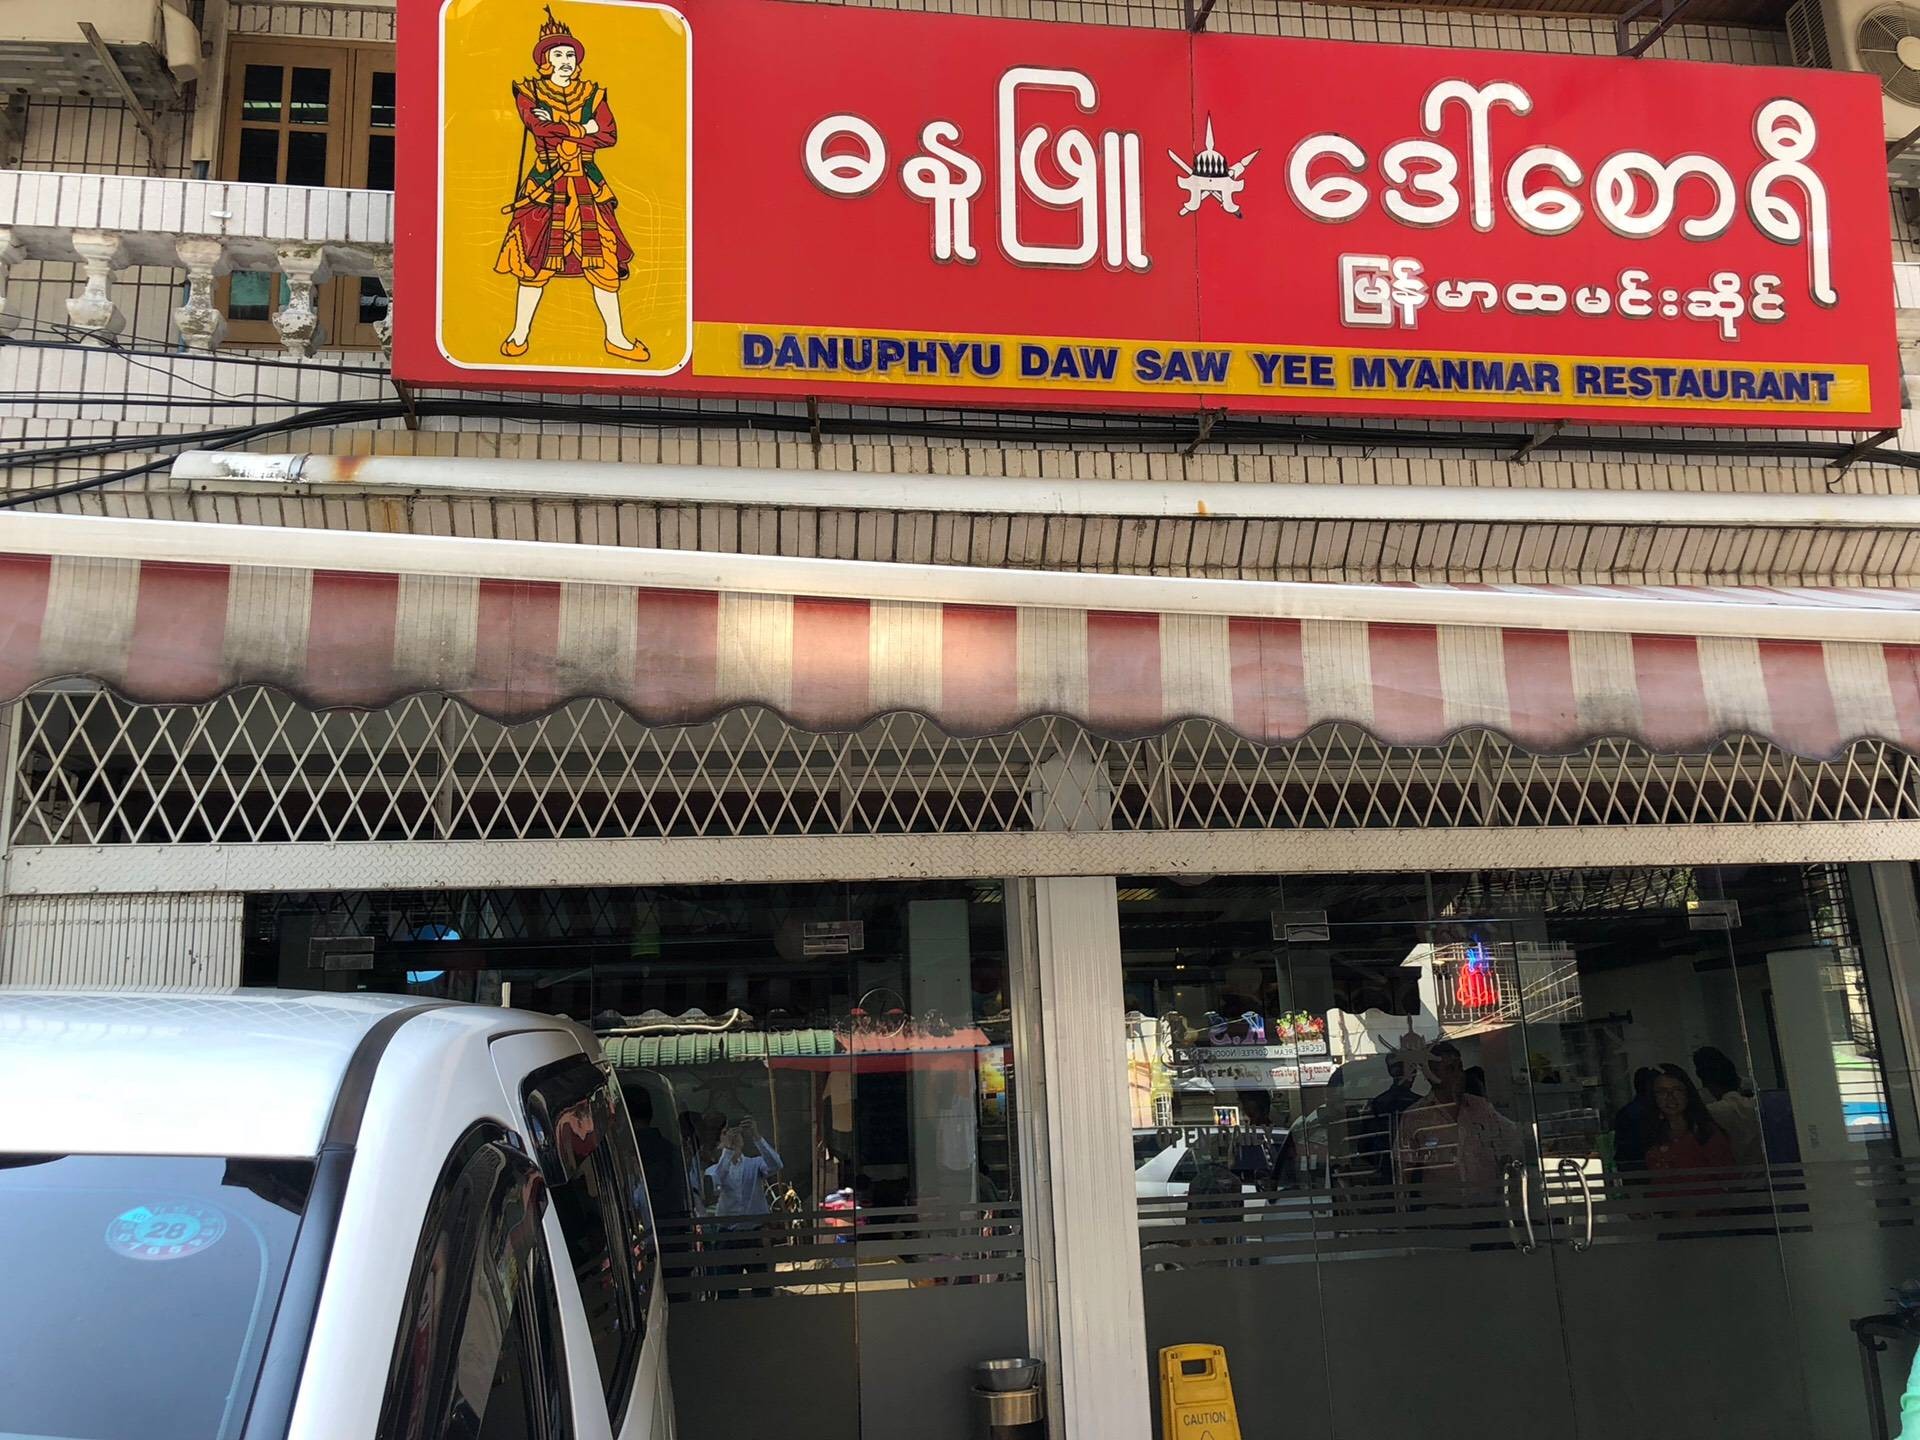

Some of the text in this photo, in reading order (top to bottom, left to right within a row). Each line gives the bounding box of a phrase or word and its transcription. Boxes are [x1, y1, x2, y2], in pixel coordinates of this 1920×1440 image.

[743, 334, 1835, 403] DANUPHYU DAW SAW YEE MYANMAR RESTAURANT
[1156, 1126, 1210, 1149] OPEN
[144, 1222, 187, 1239] 28
[1183, 1411, 1226, 1426] CAUTION
